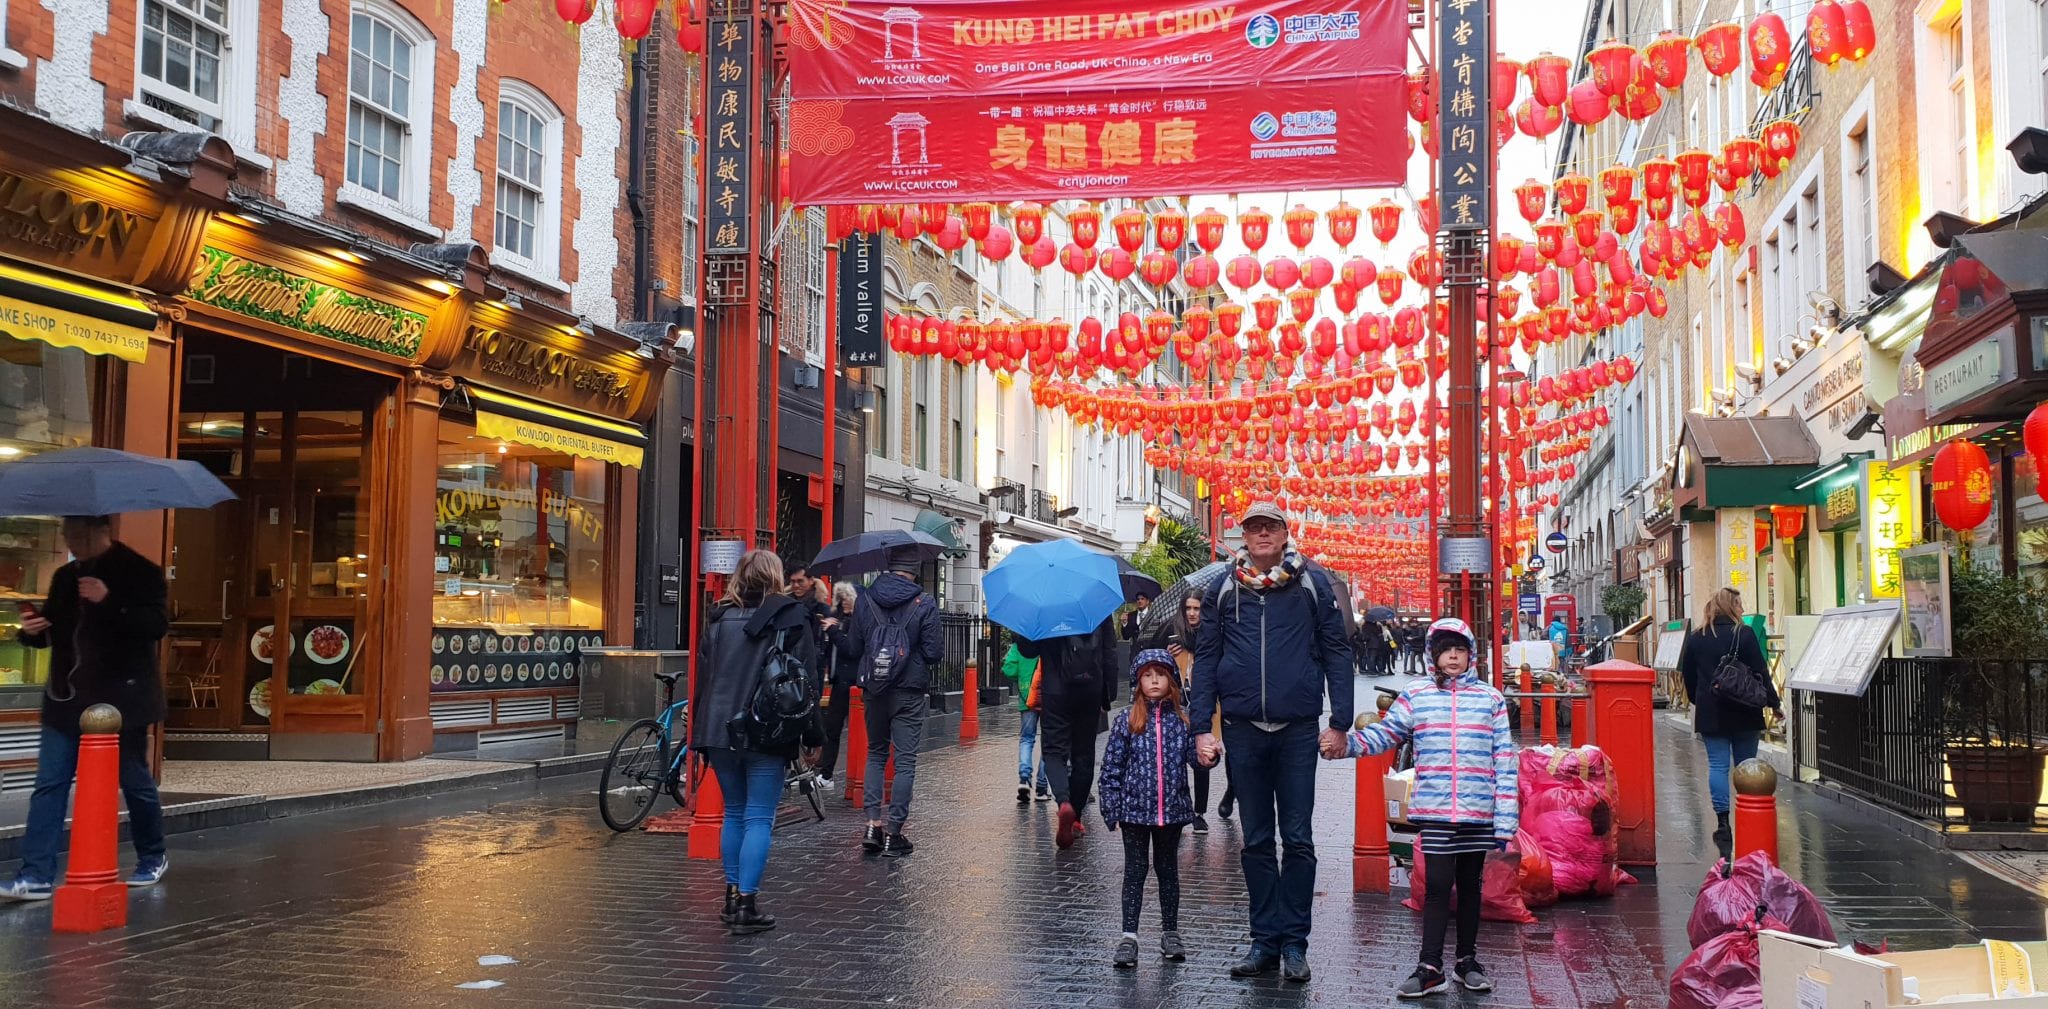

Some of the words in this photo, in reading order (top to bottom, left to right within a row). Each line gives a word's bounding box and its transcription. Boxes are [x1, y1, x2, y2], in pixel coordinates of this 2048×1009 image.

[954, 18, 1035, 46] KUNG
[1043, 14, 1090, 42] HEI
[1098, 12, 1149, 40] FAT
[1156, 6, 1235, 36] CHOY
[1285, 11, 1360, 32] 中国太平
[1285, 31, 1317, 43] CHINA
[1320, 29, 1360, 42] TAIPING
[975, 63, 999, 74] One
[1001, 61, 1025, 73] Belt
[1028, 61, 1051, 72] One
[1054, 59, 1089, 73] Road,
[1092, 54, 1151, 69] UK-China,
[1153, 58, 1161, 66] a
[1164, 54, 1188, 65] New
[1192, 52, 1212, 63] Era
[857, 74, 949, 85] WWW.LCCAUK.COM
[1282, 110, 1337, 126] 中国移动
[1282, 124, 1306, 136] China
[1307, 123, 1337, 135] Mobile
[989, 117, 1198, 171] 身體健康
[1251, 146, 1337, 159] INTERNATIONAL
[864, 180, 958, 191] WWW.LCCAUK.COM
[1058, 174, 1129, 188] #cnylondon
[0, 174, 138, 248] LOON
[855, 281, 872, 334] valley
[23, 311, 56, 333] SHOP
[64, 322, 91, 340] T:020
[94, 330, 118, 346] 7437
[122, 337, 145, 352] 1694
[465, 325, 578, 377] KOWLOON
[1934, 354, 1984, 395] RESTAURANT
[516, 425, 555, 444] KOWLOON
[557, 434, 590, 451] ORIENTAL
[591, 443, 615, 456] BUFFET
[682, 423, 695, 439] plu
[1892, 426, 1931, 462] LONDON
[436, 481, 538, 525] KOWLOON
[541, 487, 603, 543] BUFFET
